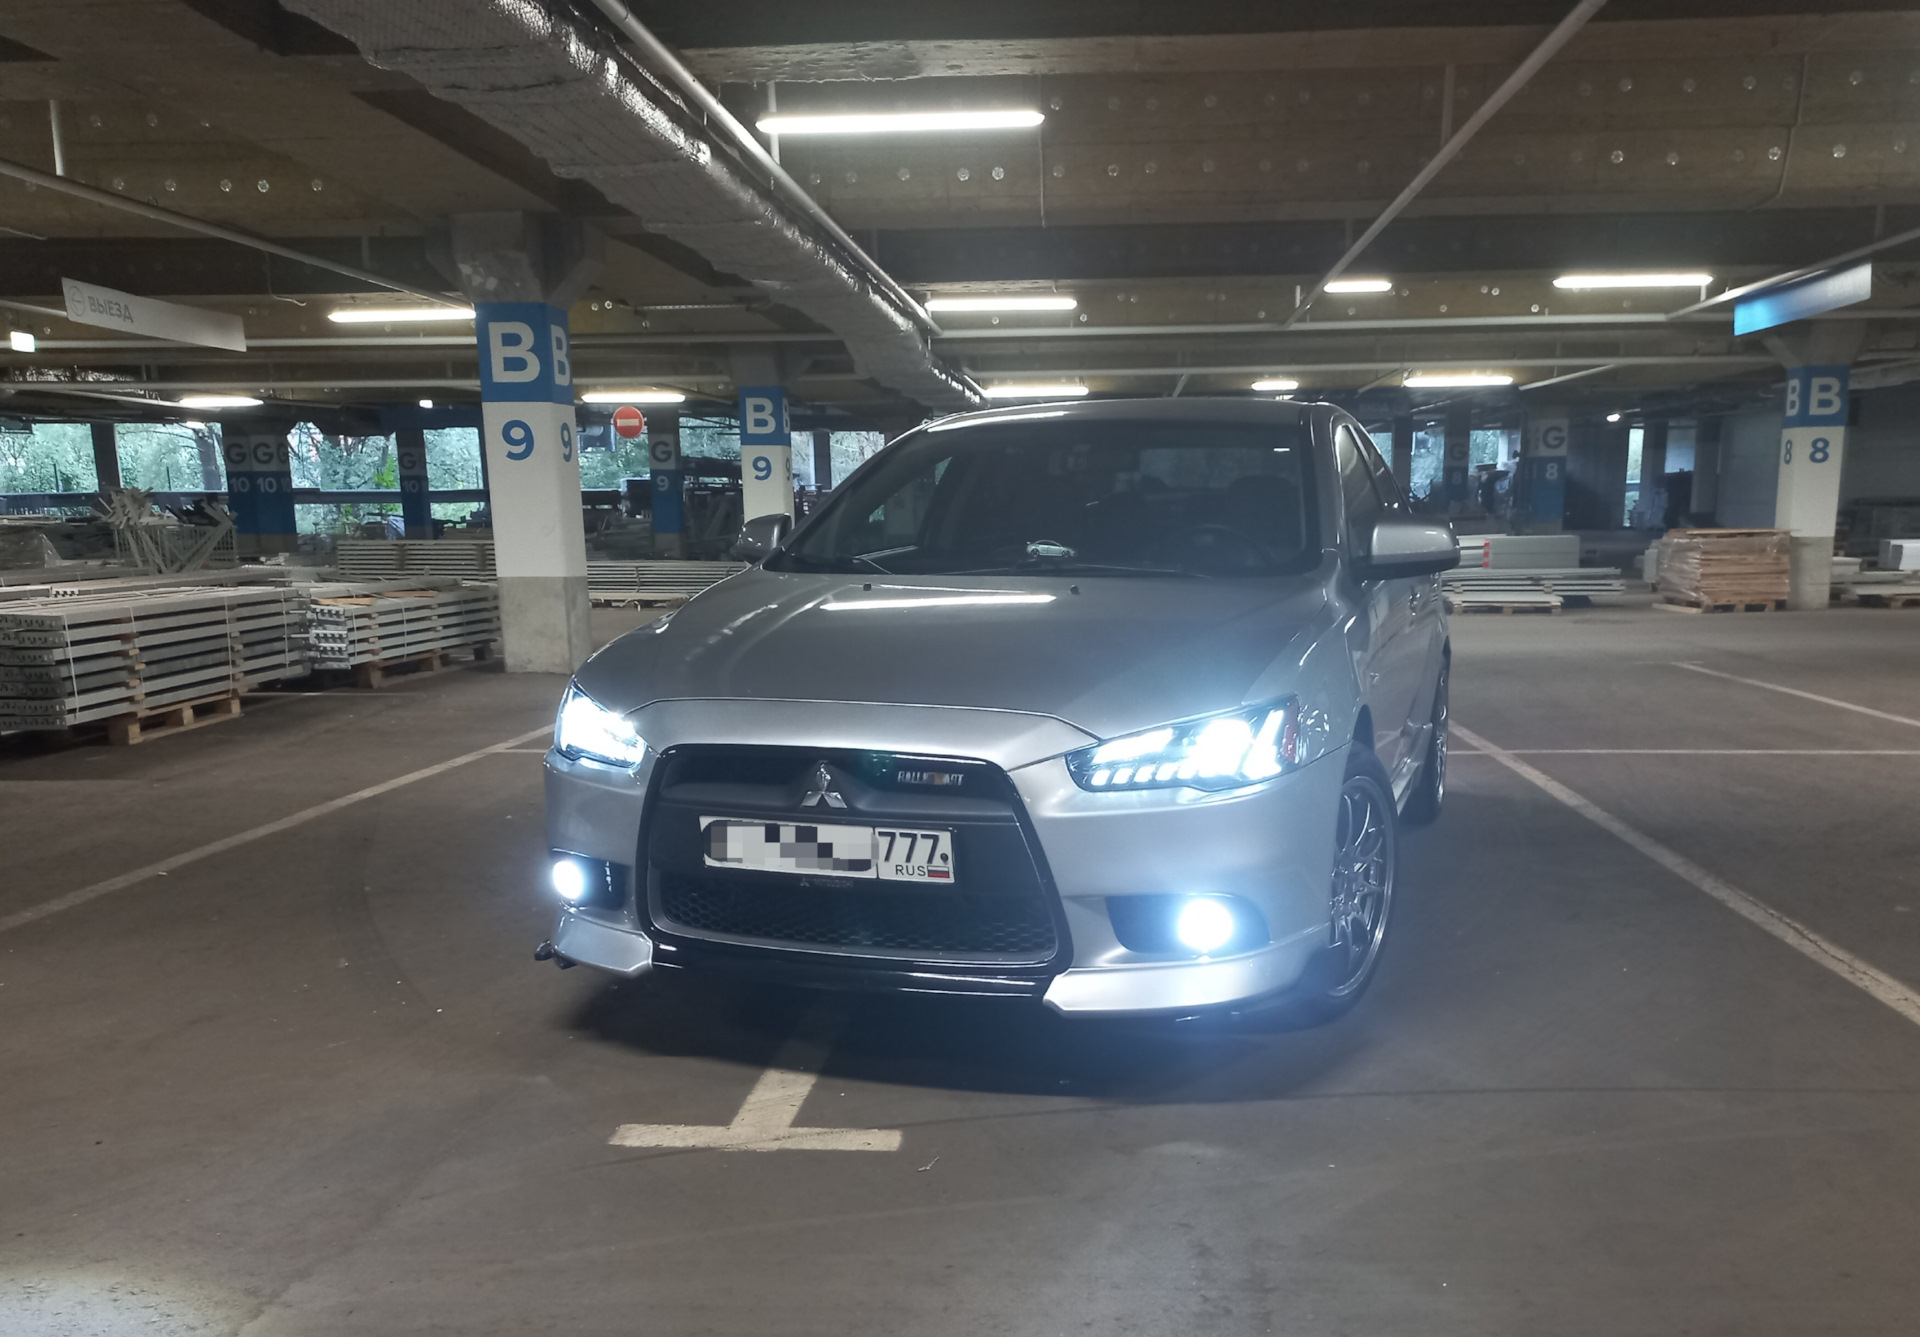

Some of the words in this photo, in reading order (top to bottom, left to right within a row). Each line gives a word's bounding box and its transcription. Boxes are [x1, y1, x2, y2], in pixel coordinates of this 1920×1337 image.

[88, 296, 133, 323] ВЫЕЗД
[488, 321, 541, 383] B
[551, 324, 571, 386] B
[1785, 378, 1800, 416] B
[1809, 377, 1842, 415] B
[745, 397, 776, 434] B
[501, 419, 535, 461] 9
[560, 422, 573, 463] 9
[1541, 426, 1566, 449] G
[1809, 437, 1830, 463] 8
[226, 443, 248, 465] G
[252, 442, 275, 465] G
[400, 452, 417, 469] G
[652, 441, 673, 463] G
[1783, 440, 1793, 465] 8
[752, 456, 773, 481] 9
[1545, 463, 1559, 480] 8
[229, 476, 250, 493] 10
[256, 476, 278, 493] 10
[402, 479, 419, 492] 10
[656, 475, 669, 491] 9
[878, 831, 940, 865] 777
[895, 864, 926, 877] RUS
